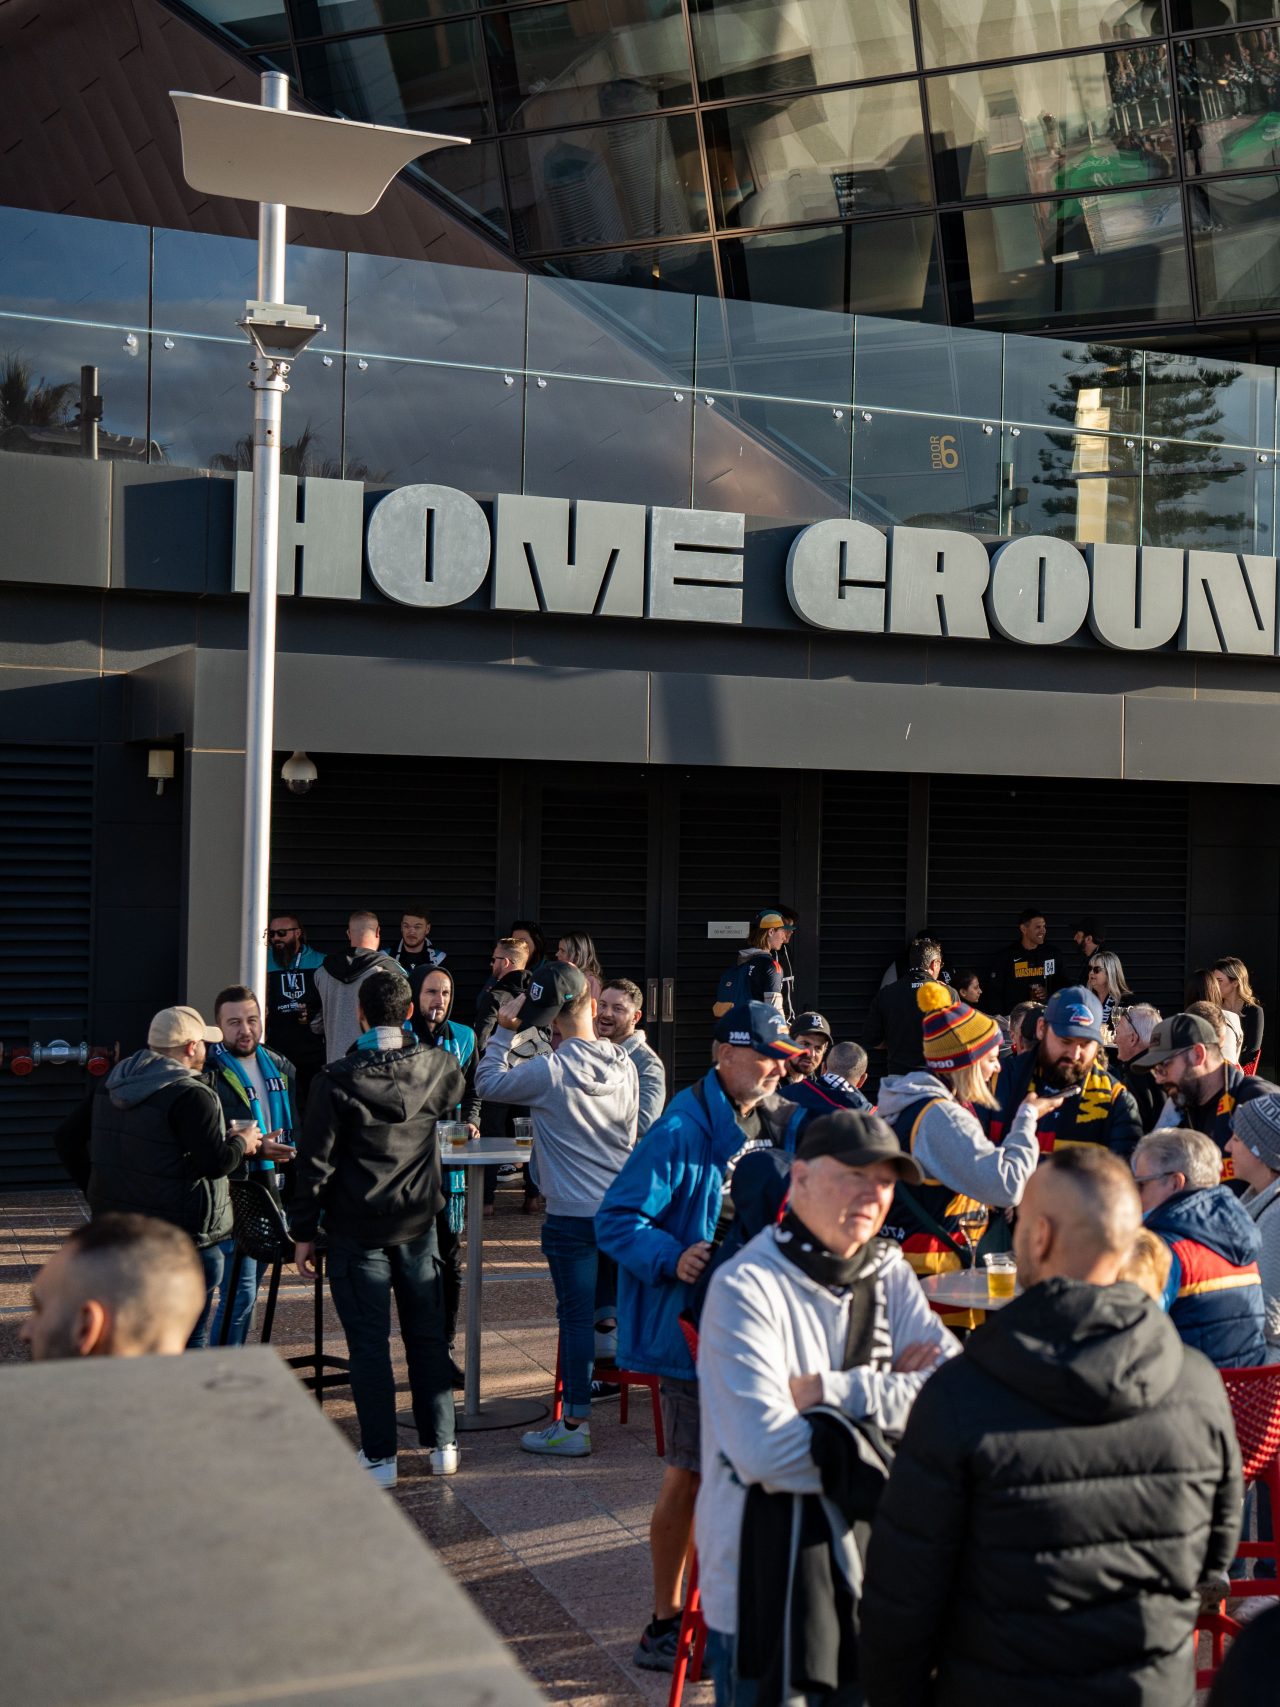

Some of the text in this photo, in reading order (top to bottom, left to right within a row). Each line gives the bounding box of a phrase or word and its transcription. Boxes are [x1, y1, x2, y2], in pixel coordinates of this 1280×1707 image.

[930, 435, 942, 469] DOOR
[940, 435, 959, 469] 6
[231, 470, 746, 624] HOME
[880, 1222, 906, 1240] OTA
